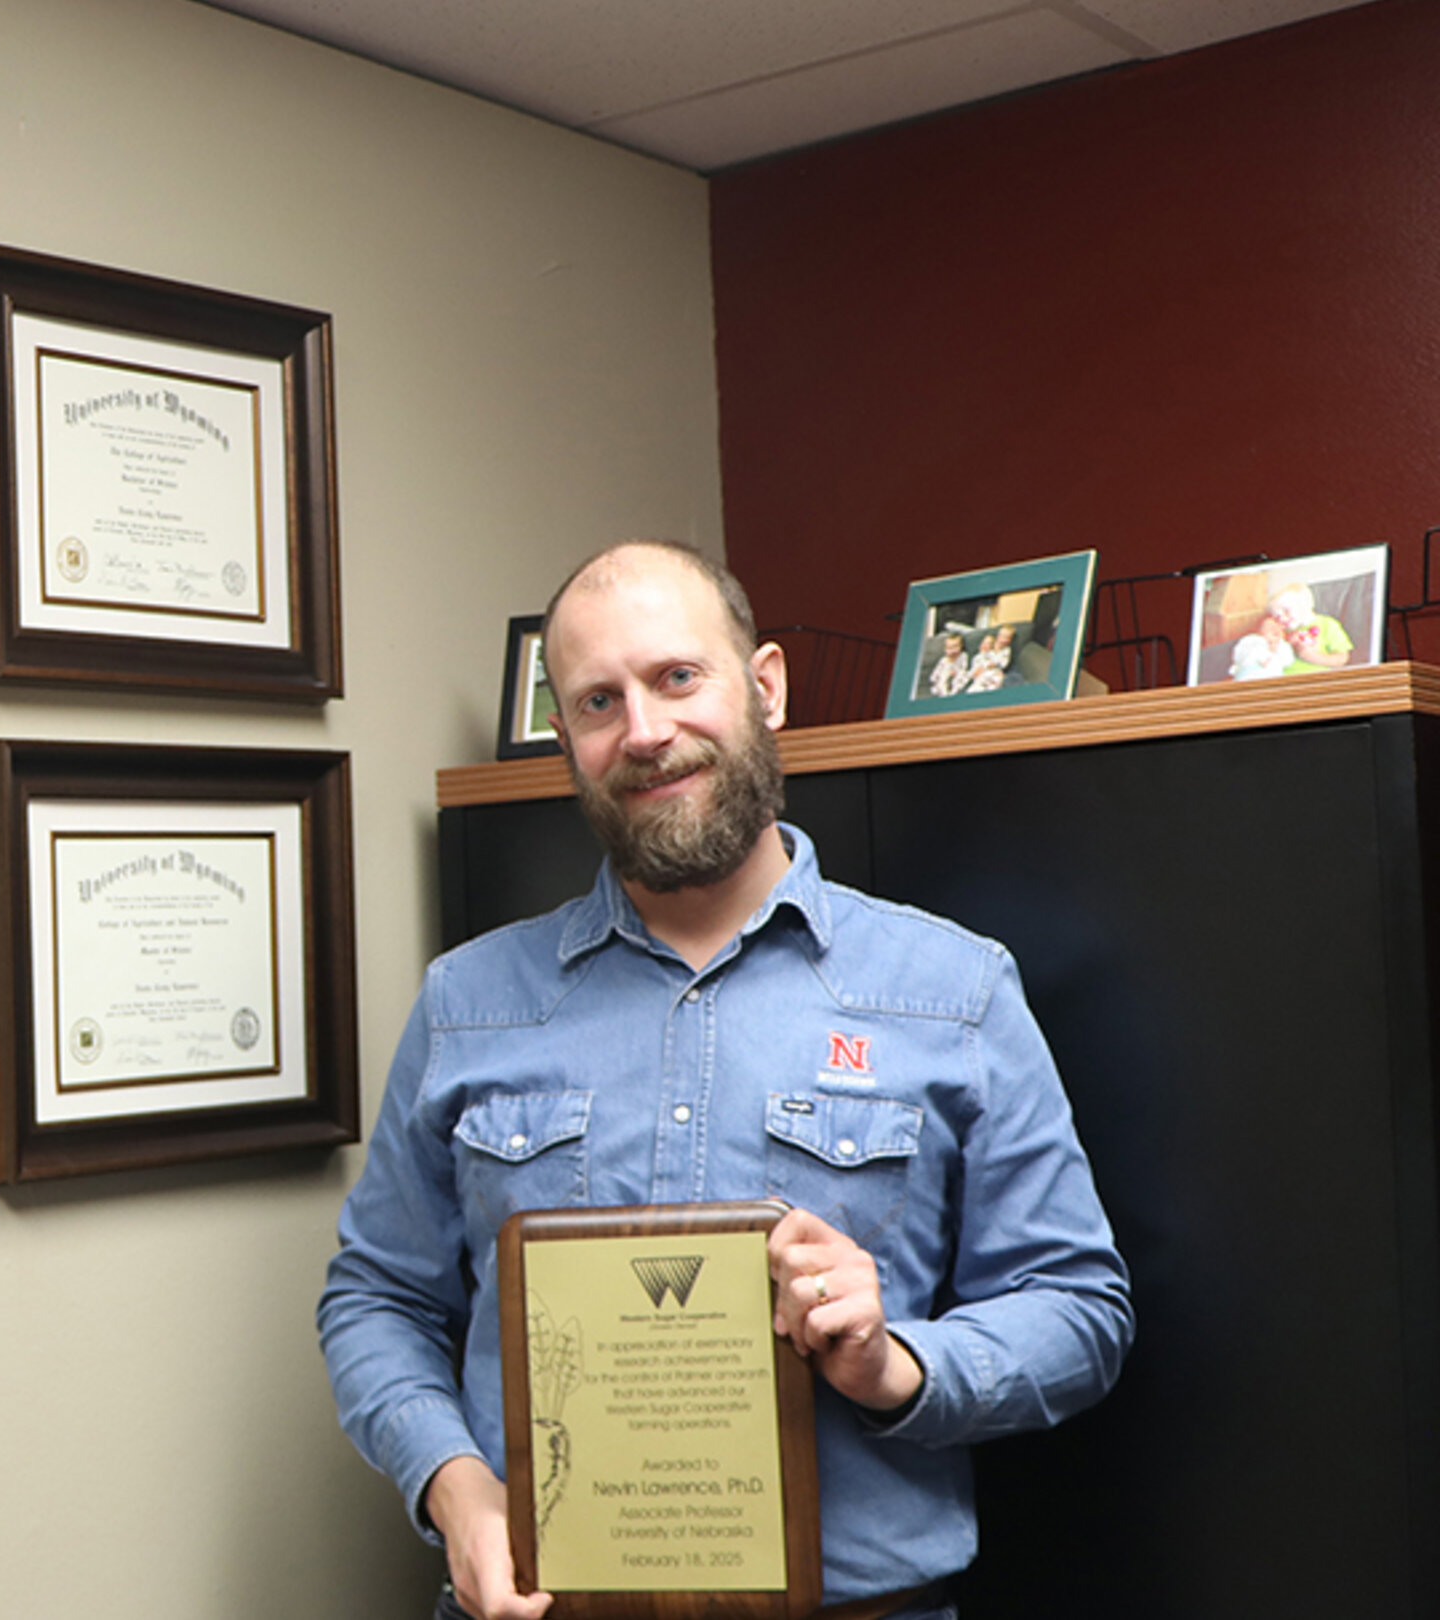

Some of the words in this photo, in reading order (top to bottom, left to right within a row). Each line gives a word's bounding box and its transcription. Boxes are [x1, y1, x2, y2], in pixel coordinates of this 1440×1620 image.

[64, 390, 141, 425] University
[146, 391, 159, 408] of
[163, 390, 229, 452] Wyoming
[78, 855, 157, 903] University
[161, 853, 174, 870] of
[178, 849, 245, 904] Wyoming
[828, 1030, 871, 1072] N
[597, 1342, 607, 1352] In
[611, 1340, 681, 1355] appreciation
[684, 1338, 692, 1349] of
[696, 1337, 753, 1350] exemplary
[614, 1354, 659, 1367] research
[664, 1353, 741, 1365] achievements
[584, 1373, 598, 1383] for
[601, 1372, 619, 1383] the
[622, 1371, 658, 1383] control
[662, 1371, 673, 1382] of
[675, 1370, 712, 1381] Palmer
[715, 1368, 768, 1380] amaranth
[613, 1388, 633, 1399] that
[637, 1386, 666, 1398] have
[670, 1386, 725, 1397] advanced
[729, 1386, 745, 1397] our
[606, 1404, 646, 1415] Western
[650, 1402, 680, 1416] Sugar
[684, 1401, 751, 1414] Cooperative
[628, 1419, 671, 1432] farming
[642, 1459, 701, 1472] Awarded
[705, 1460, 719, 1470] to
[594, 1481, 638, 1497] Nevin
[642, 1479, 722, 1496] Lawrence,
[619, 1506, 682, 1519] Associate
[686, 1506, 744, 1518] Professor
[611, 1526, 670, 1540] University
[674, 1525, 687, 1538] of
[690, 1525, 753, 1538] Nebraska
[622, 1554, 680, 1569] February
[710, 1553, 744, 1566] 2025
